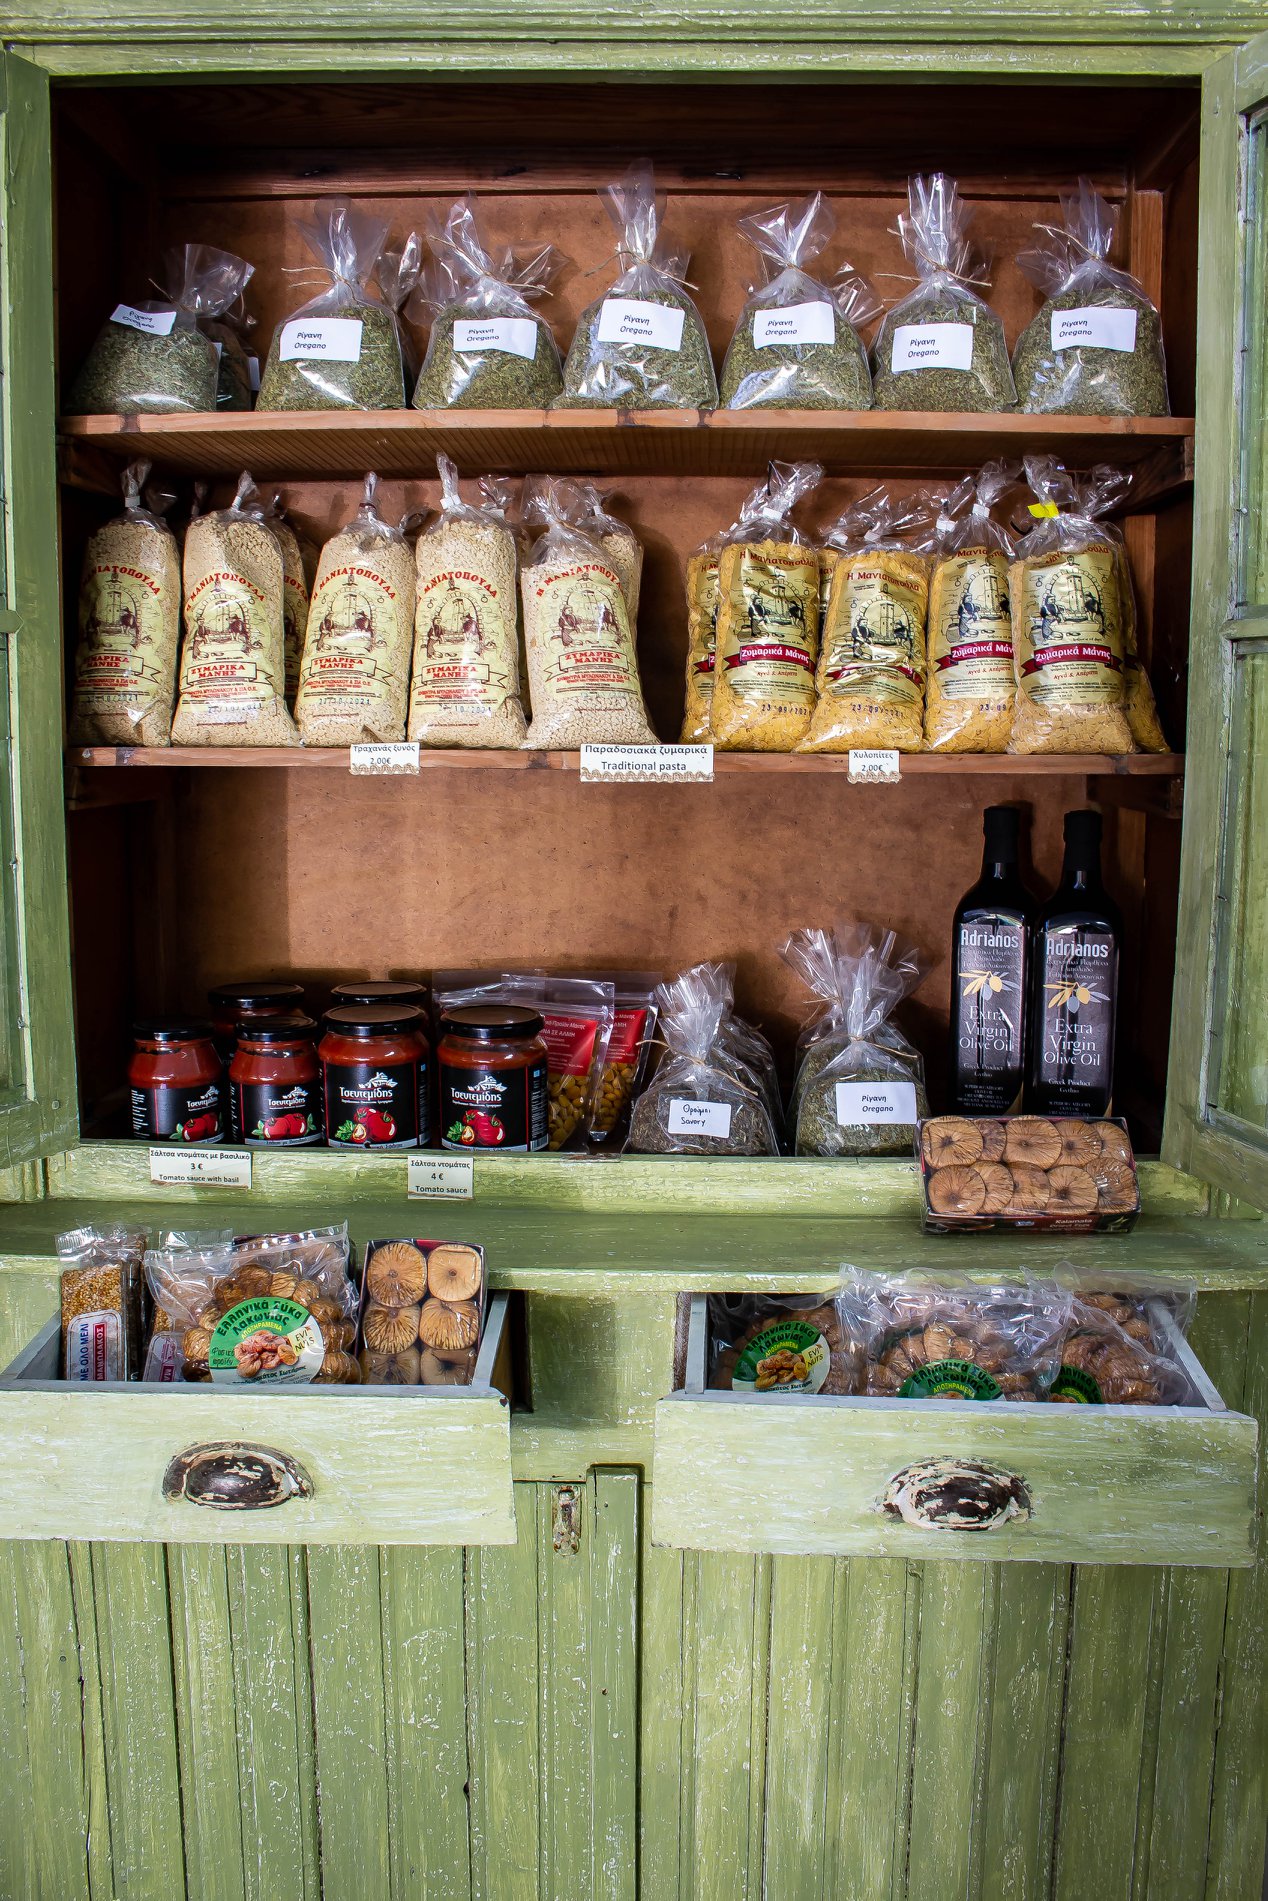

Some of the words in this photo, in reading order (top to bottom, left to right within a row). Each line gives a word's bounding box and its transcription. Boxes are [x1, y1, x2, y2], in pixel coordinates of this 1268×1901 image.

[624, 315, 650, 326] Ρίγανη
[768, 320, 793, 328] Ρίγανη
[1061, 320, 1088, 328] Ρίγανη
[620, 325, 653, 336] Oregano
[765, 328, 798, 336] Oregano
[1059, 329, 1093, 338] Oregano
[297, 332, 322, 341] Ρίγανη
[467, 335, 500, 343] Oregano
[294, 342, 326, 351] Oregano
[910, 338, 936, 348] Ρίγανη
[907, 348, 940, 358] Oregano
[739, 551, 746, 559] Η
[750, 553, 815, 568] Μανιατοπούλα
[847, 573, 854, 581] Η
[190, 572, 265, 603] ΜΑΝΙΑΤΟΠΟΥΛΑ
[319, 567, 396, 600] ΜΑΝΙΑΤΟΠΟΥΛΑ
[423, 571, 498, 599] ΜΑΝΙΑΤΟΠΟΥΛΑ
[565, 651, 621, 660] ΖΥΜΑΡΙΚΑ
[742, 646, 783, 658] Ζυμαρικά
[785, 648, 810, 664] Μάνης
[952, 643, 993, 658] Ζυμαρικά
[996, 644, 1013, 652] Μάν
[1035, 645, 1079, 662] Ζυμαρικά
[1082, 646, 1111, 659] Μάνης
[313, 657, 364, 666] ΖΥΜΑΡΙΚΑ
[319, 662, 355, 670] ΜΑΝΗΣ
[190, 664, 246, 675] ΖΥΜΑΡΙΚΑ
[198, 669, 237, 679] ΜΑΝΗΣ
[426, 664, 478, 674] ΖΥΜΑΡΙΚΑ
[432, 670, 469, 679] ΜΑΝΗΣ
[353, 745, 392, 753] Τραχανάς
[393, 744, 416, 752] ξυνός
[585, 744, 657, 755] Παραδοσιακά
[659, 745, 708, 756] ζυμαρικά
[853, 751, 894, 760] Χυλοπίτες
[601, 761, 656, 771] Traditional
[659, 762, 687, 772] pasta
[960, 929, 1019, 948] Adrianos
[1045, 938, 1109, 958] Adrianos
[969, 1005, 1006, 1021] Extra
[965, 1021, 1008, 1041] Virgin
[1055, 1018, 1093, 1035] Extra
[959, 1036, 991, 1050] Olive
[993, 1038, 1012, 1052] Oil
[1049, 1035, 1096, 1056] Virgin
[1044, 1051, 1077, 1065] Olive
[1080, 1053, 1101, 1066] Oil
[339, 1086, 393, 1101] Τσευτεμίδης
[450, 1087, 502, 1104] Τσευτεμίδης
[861, 1094, 887, 1104] Ρίγανη
[268, 1097, 306, 1107] Τσευτεμίδης
[862, 1105, 894, 1114] Oregano
[680, 1116, 706, 1127] Savory
[177, 1151, 209, 1159] ντομάτας
[209, 1152, 219, 1160] με
[219, 1152, 250, 1161] βασιλικό
[190, 1162, 196, 1170] 3
[411, 1159, 436, 1167] Σάλτσα
[437, 1161, 471, 1169] ντομάτας
[438, 1172, 444, 1181] €
[415, 1185, 445, 1193] Tomato
[446, 1186, 468, 1194] sauce
[216, 1300, 269, 1337] Ελληνικά
[273, 1300, 303, 1320] Σύκα
[231, 1311, 290, 1336] Λακωνίας
[80, 1323, 89, 1346] ΜΕΛΙ
[295, 1329, 309, 1342] EVI
[793, 1322, 815, 1338] Σύκα
[759, 1331, 804, 1354] Λακωνίας
[808, 1354, 824, 1368] NUTS
[80, 1368, 89, 1381] ΜΕ
[911, 1361, 968, 1385] Ελληνικά
